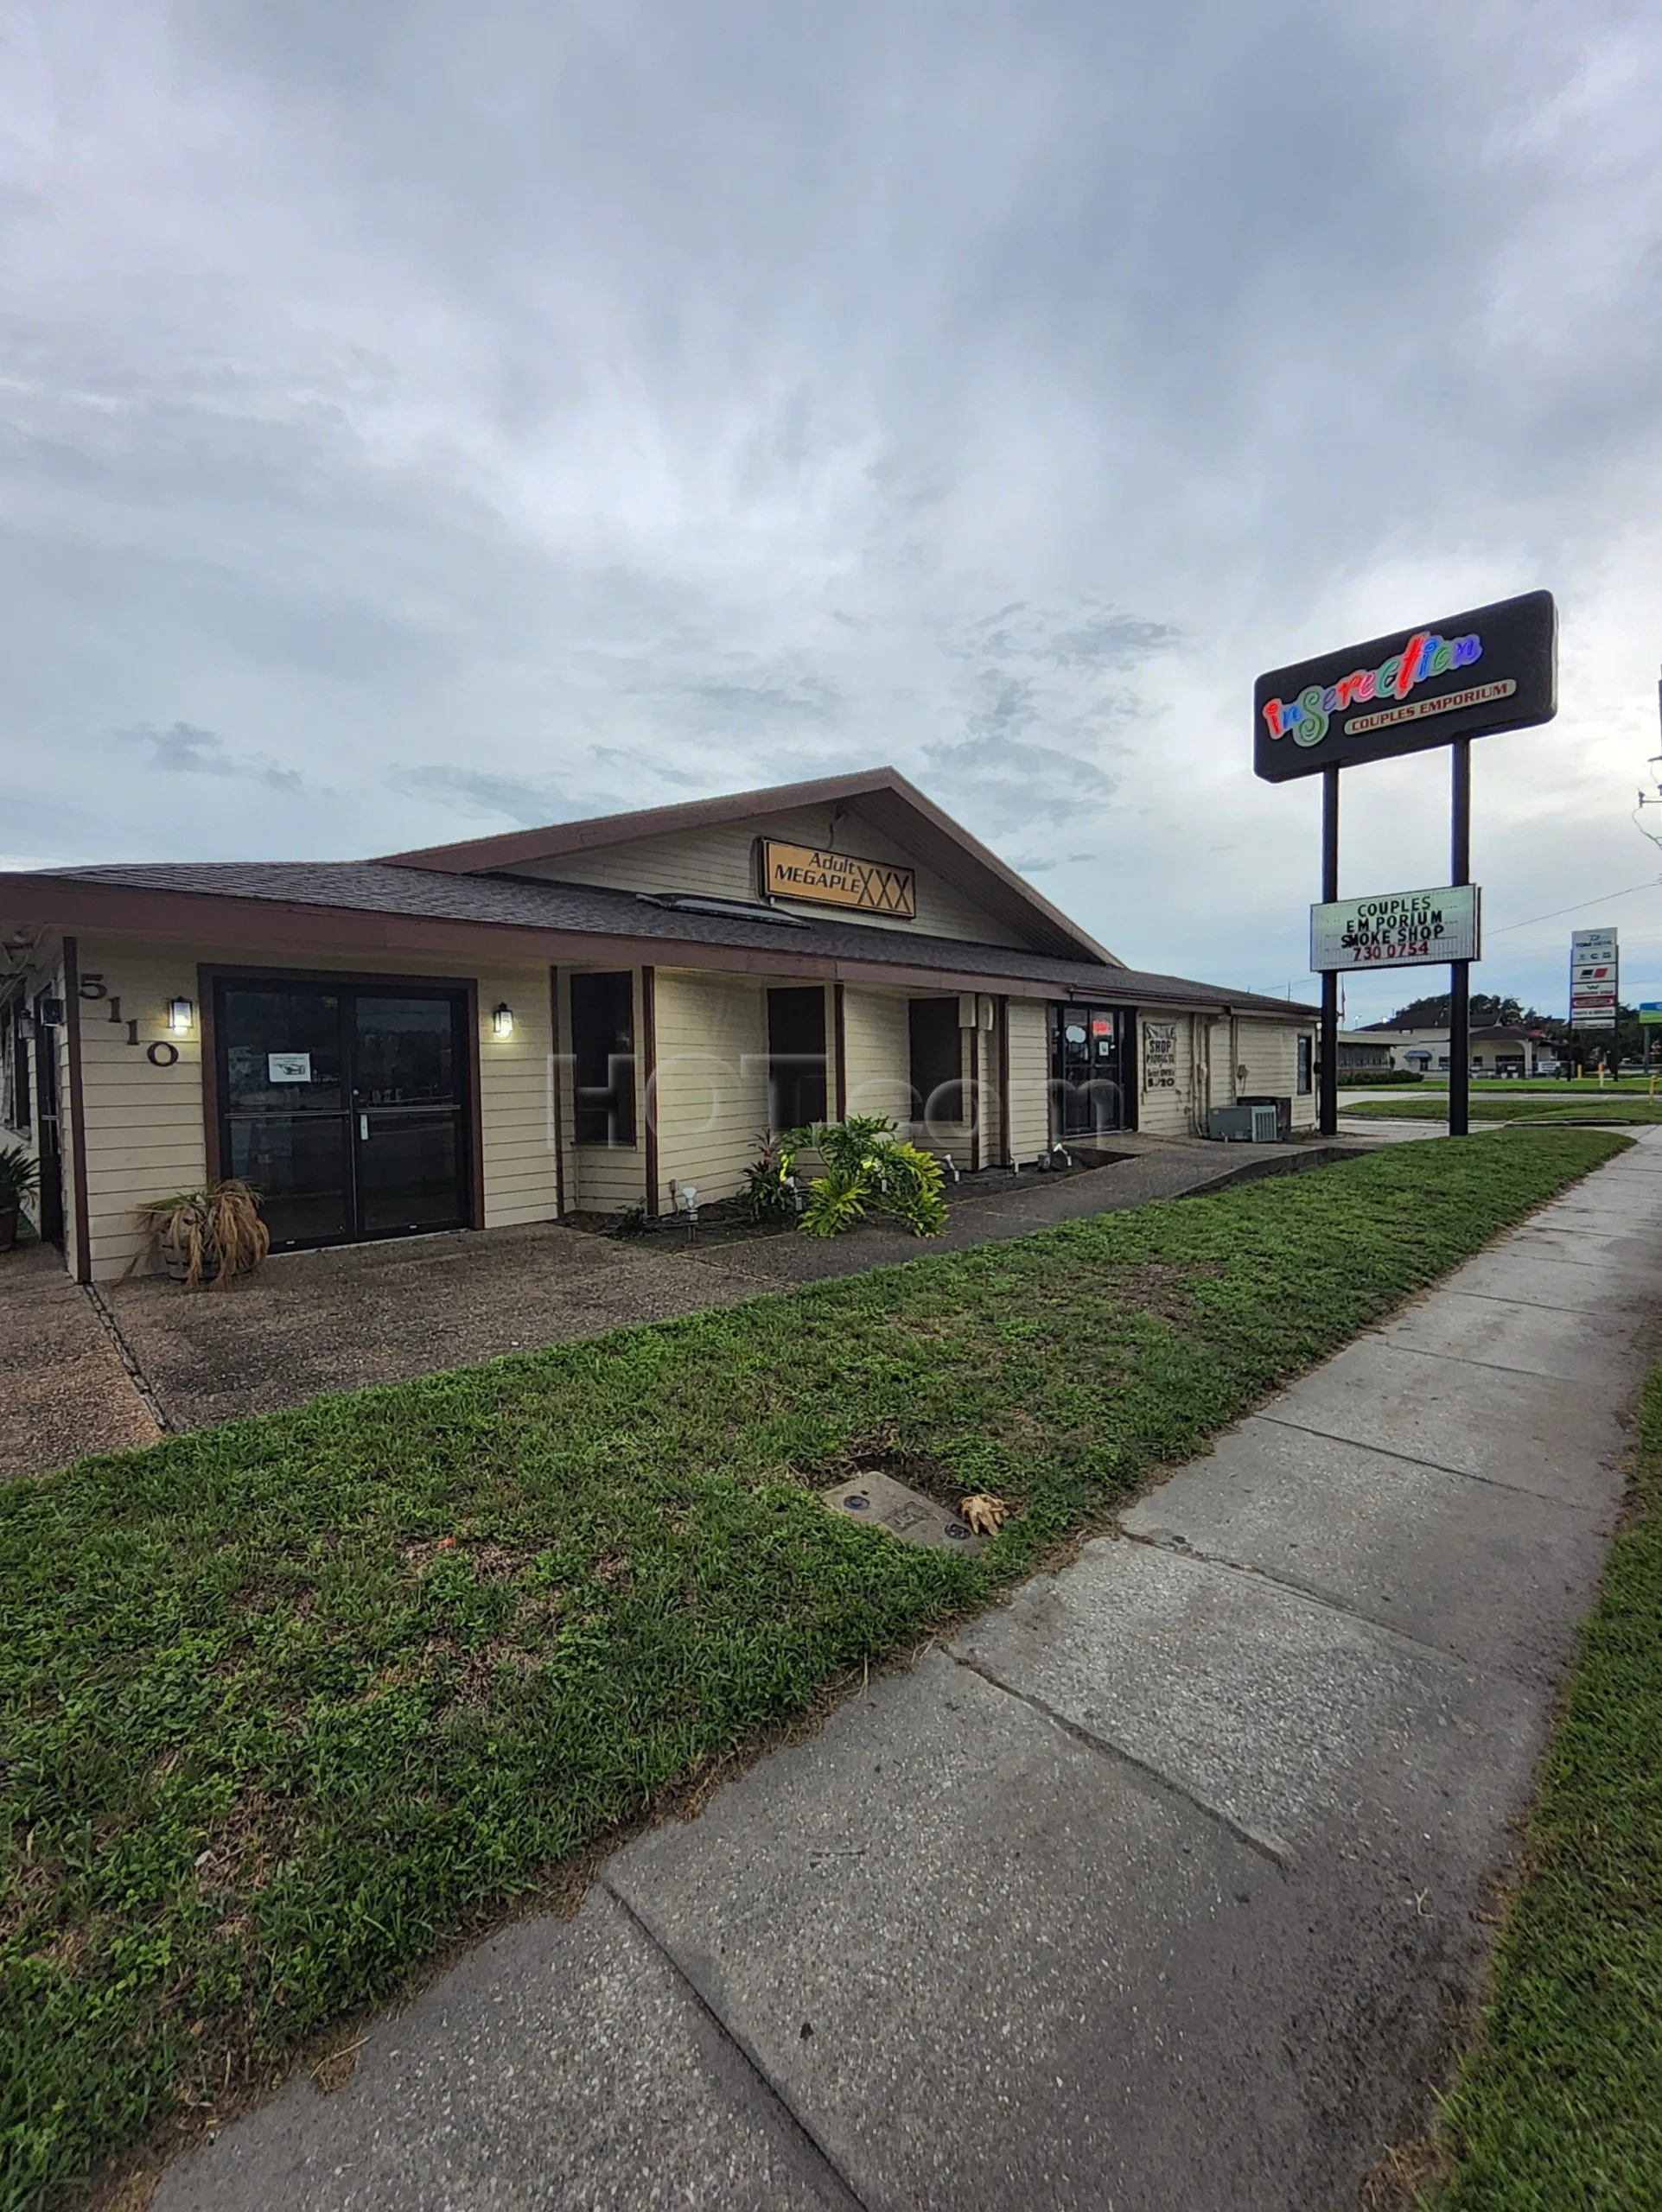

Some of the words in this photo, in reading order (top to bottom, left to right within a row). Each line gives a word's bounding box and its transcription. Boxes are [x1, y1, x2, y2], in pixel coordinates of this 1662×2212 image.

[1351, 707, 1416, 731] COUPLES
[1420, 683, 1508, 715] EMPORIUM
[808, 852, 855, 875] Adult
[1358, 896, 1431, 918] COUPLES
[1341, 930, 1391, 948] SMOKE
[1398, 924, 1444, 943] SHOP
[1353, 946, 1381, 962] 730
[1386, 941, 1430, 957] 0754
[1149, 1039, 1171, 1053] SHOP
